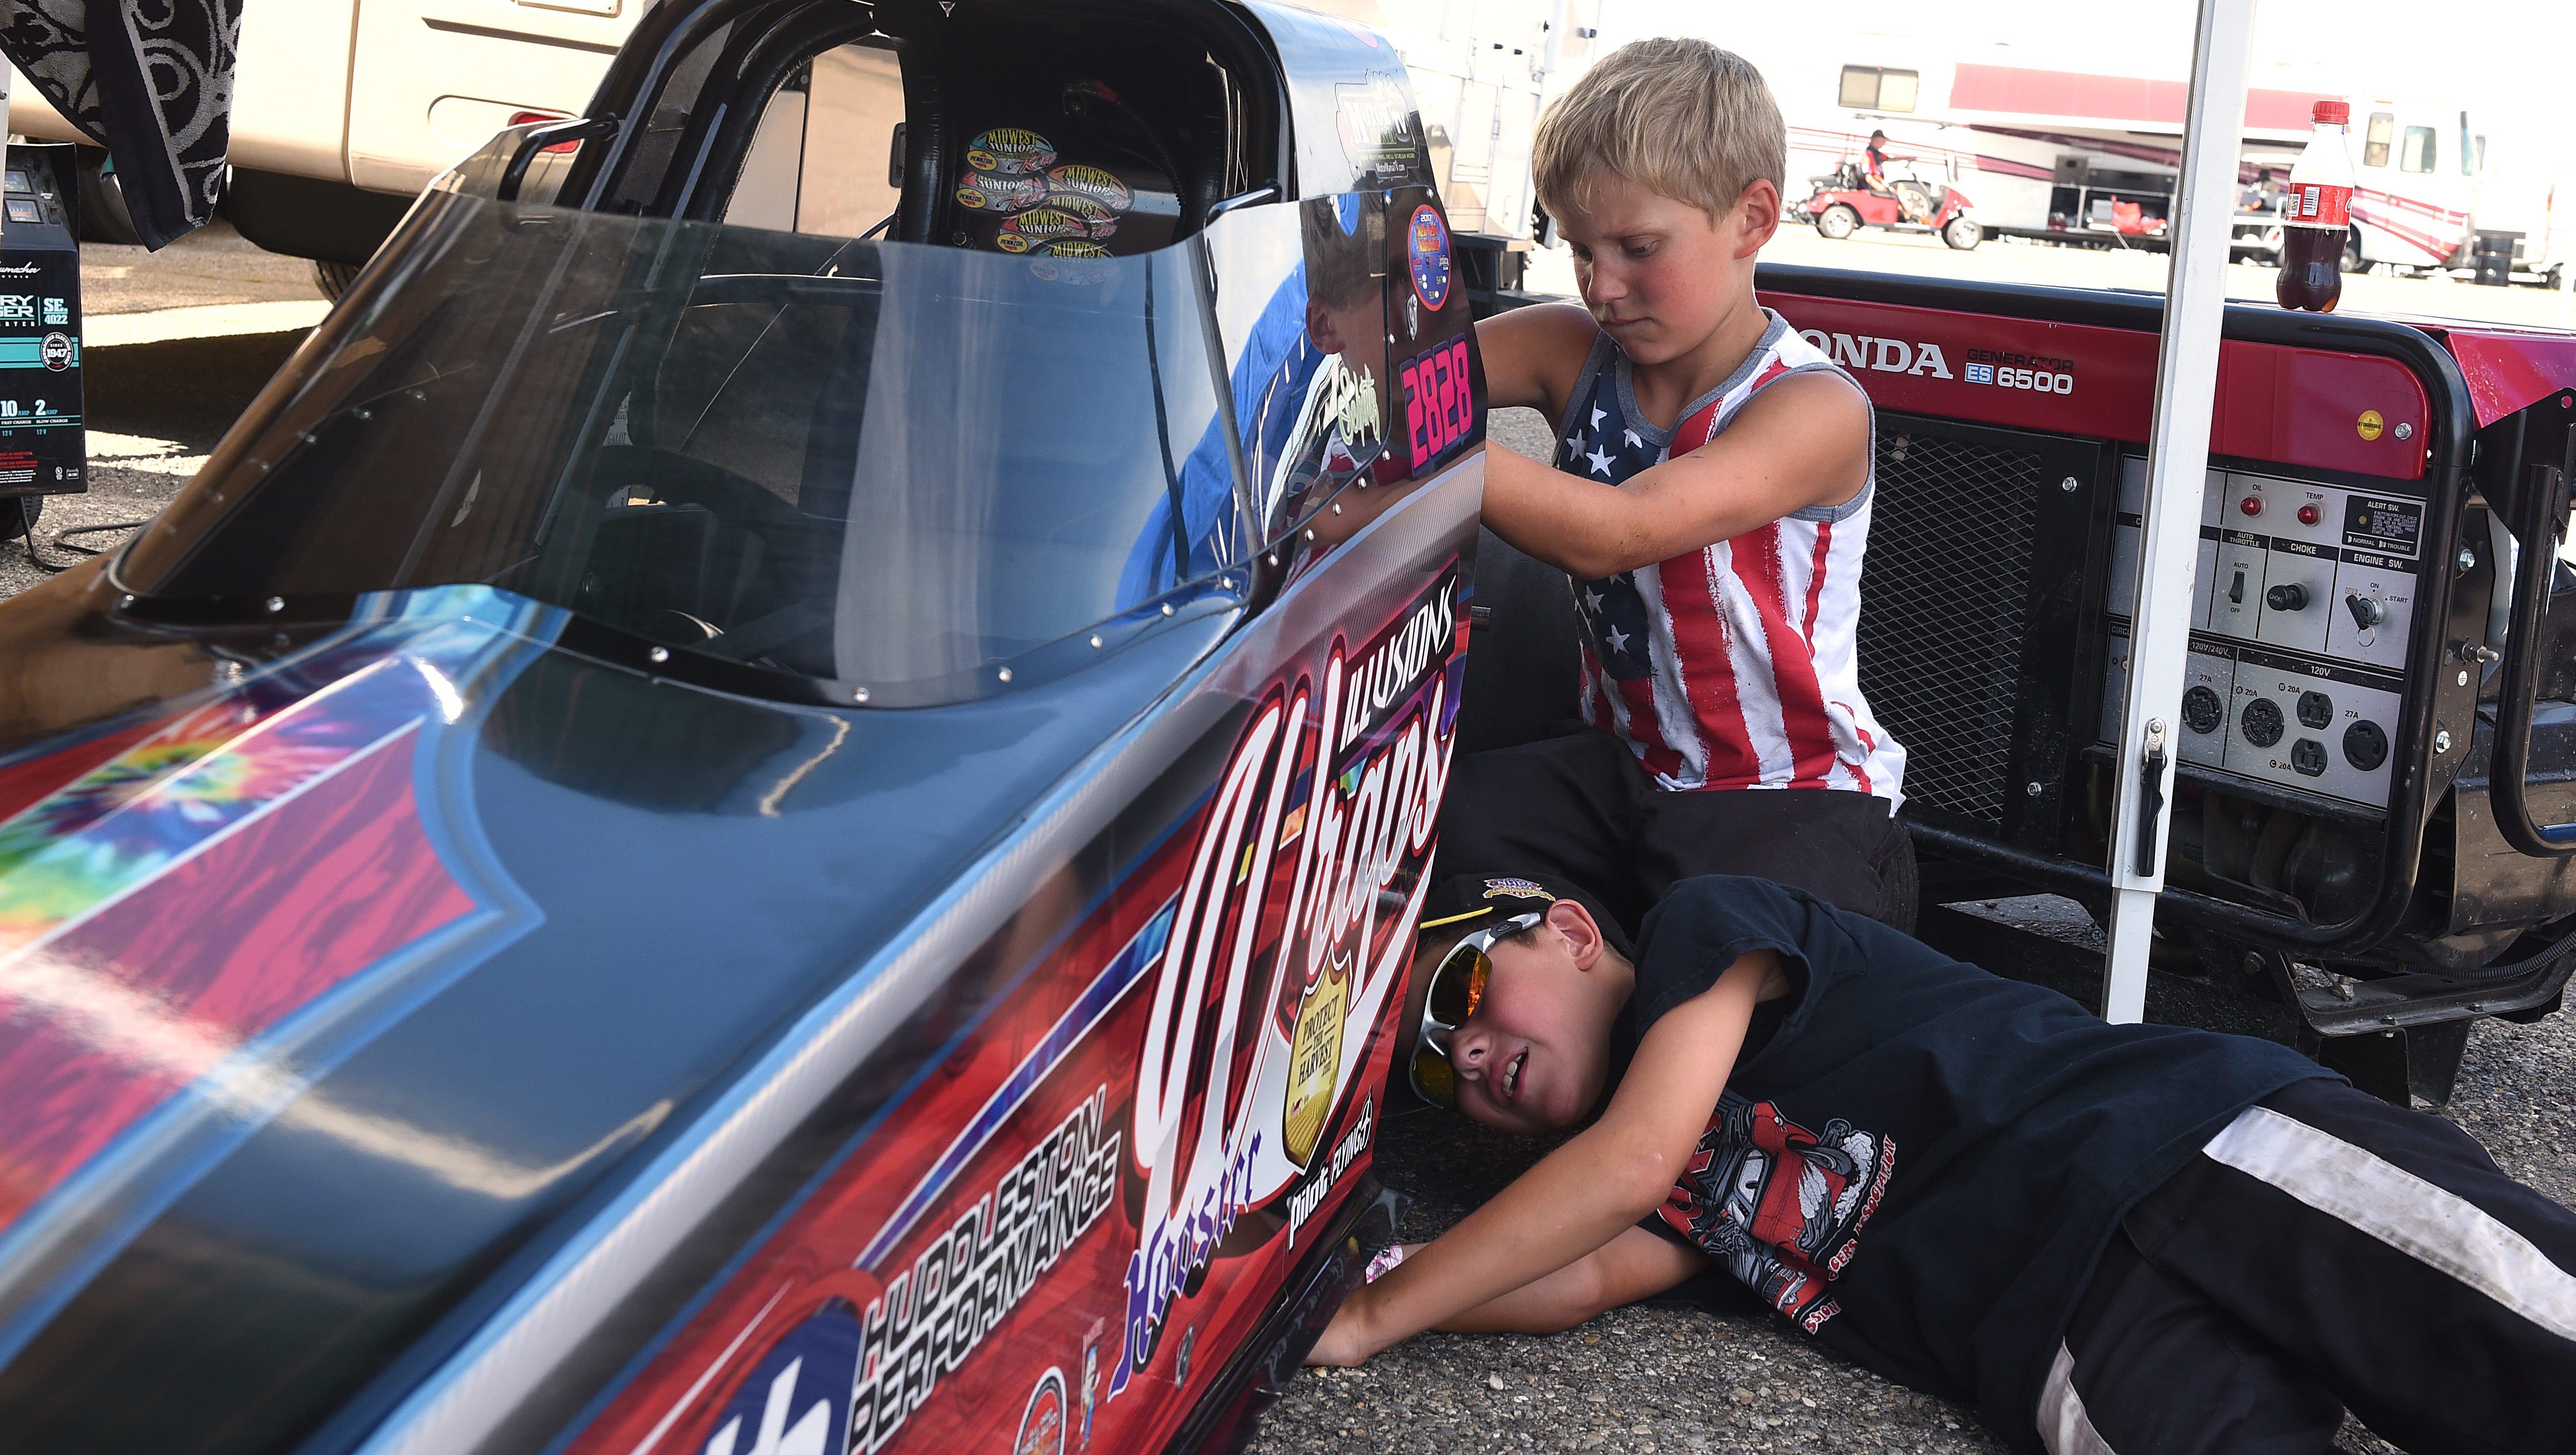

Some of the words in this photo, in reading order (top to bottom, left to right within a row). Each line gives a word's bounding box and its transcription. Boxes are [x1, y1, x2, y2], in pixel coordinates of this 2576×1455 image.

[989, 129, 1036, 146] MIDWEST
[989, 143, 1034, 153] JUNIOR
[970, 155, 994, 165] PENNZOIL
[1065, 167, 1114, 188] MIDWEST
[978, 180, 1024, 191] JUNIOR
[1065, 177, 1111, 195] JUNIOR
[959, 193, 982, 202] PENNZOIL
[1052, 197, 1099, 216] MIDWEST
[1019, 210, 1067, 225] MIDWEST
[1420, 214, 1432, 222] 2017
[1019, 224, 1065, 233] JUNIOR
[1001, 239, 1024, 247] PENNZOIL
[1053, 243, 1101, 258] MIDWEST
[0, 261, 41, 273] umacher
[44, 314, 68, 325] 4022
[47, 348, 67, 358] 1947
[1799, 329, 1953, 380] ONDA
[1967, 348, 2074, 372] GENERATOR
[1966, 365, 1992, 383] ES
[1997, 367, 2073, 395] 6500
[0, 400, 18, 417] 10
[35, 399, 46, 416] 2
[1401, 338, 1473, 472] 2828
[2306, 492, 2323, 500] TEMP
[2367, 501, 2387, 510] ALERT
[2388, 504, 2400, 512] SW.
[2229, 537, 2260, 547] THROTTLE
[2290, 542, 2317, 555] CHOKE
[2353, 538, 2375, 546] NORMAL
[2387, 543, 2410, 551] TROUBLE
[2353, 553, 2384, 566] ENGINE
[2388, 559, 2404, 569] SW.
[2268, 593, 2284, 603] CHOKE
[2389, 596, 2408, 604] START
[2191, 641, 2229, 656] 120V/240V
[1339, 574, 1457, 753] ILLUSIONS
[2310, 665, 2331, 677] 120V
[2199, 674, 2212, 684] 27A
[2245, 688, 2258, 697] 20A
[2288, 685, 2300, 694] 20A
[2345, 710, 2359, 719] 27A
[2278, 762, 2291, 771] 20A
[1302, 994, 1340, 1046] PROTECT
[1313, 1029, 1324, 1052] THE
[1297, 1035, 1335, 1088] HARVEST
[1330, 1120, 1365, 1187] FLYING
[856, 1083, 1107, 1388] HUDDLESTON
[1107, 1128, 1262, 1403] Hoosier
[842, 1130, 1121, 1455] PERFORMANCE
